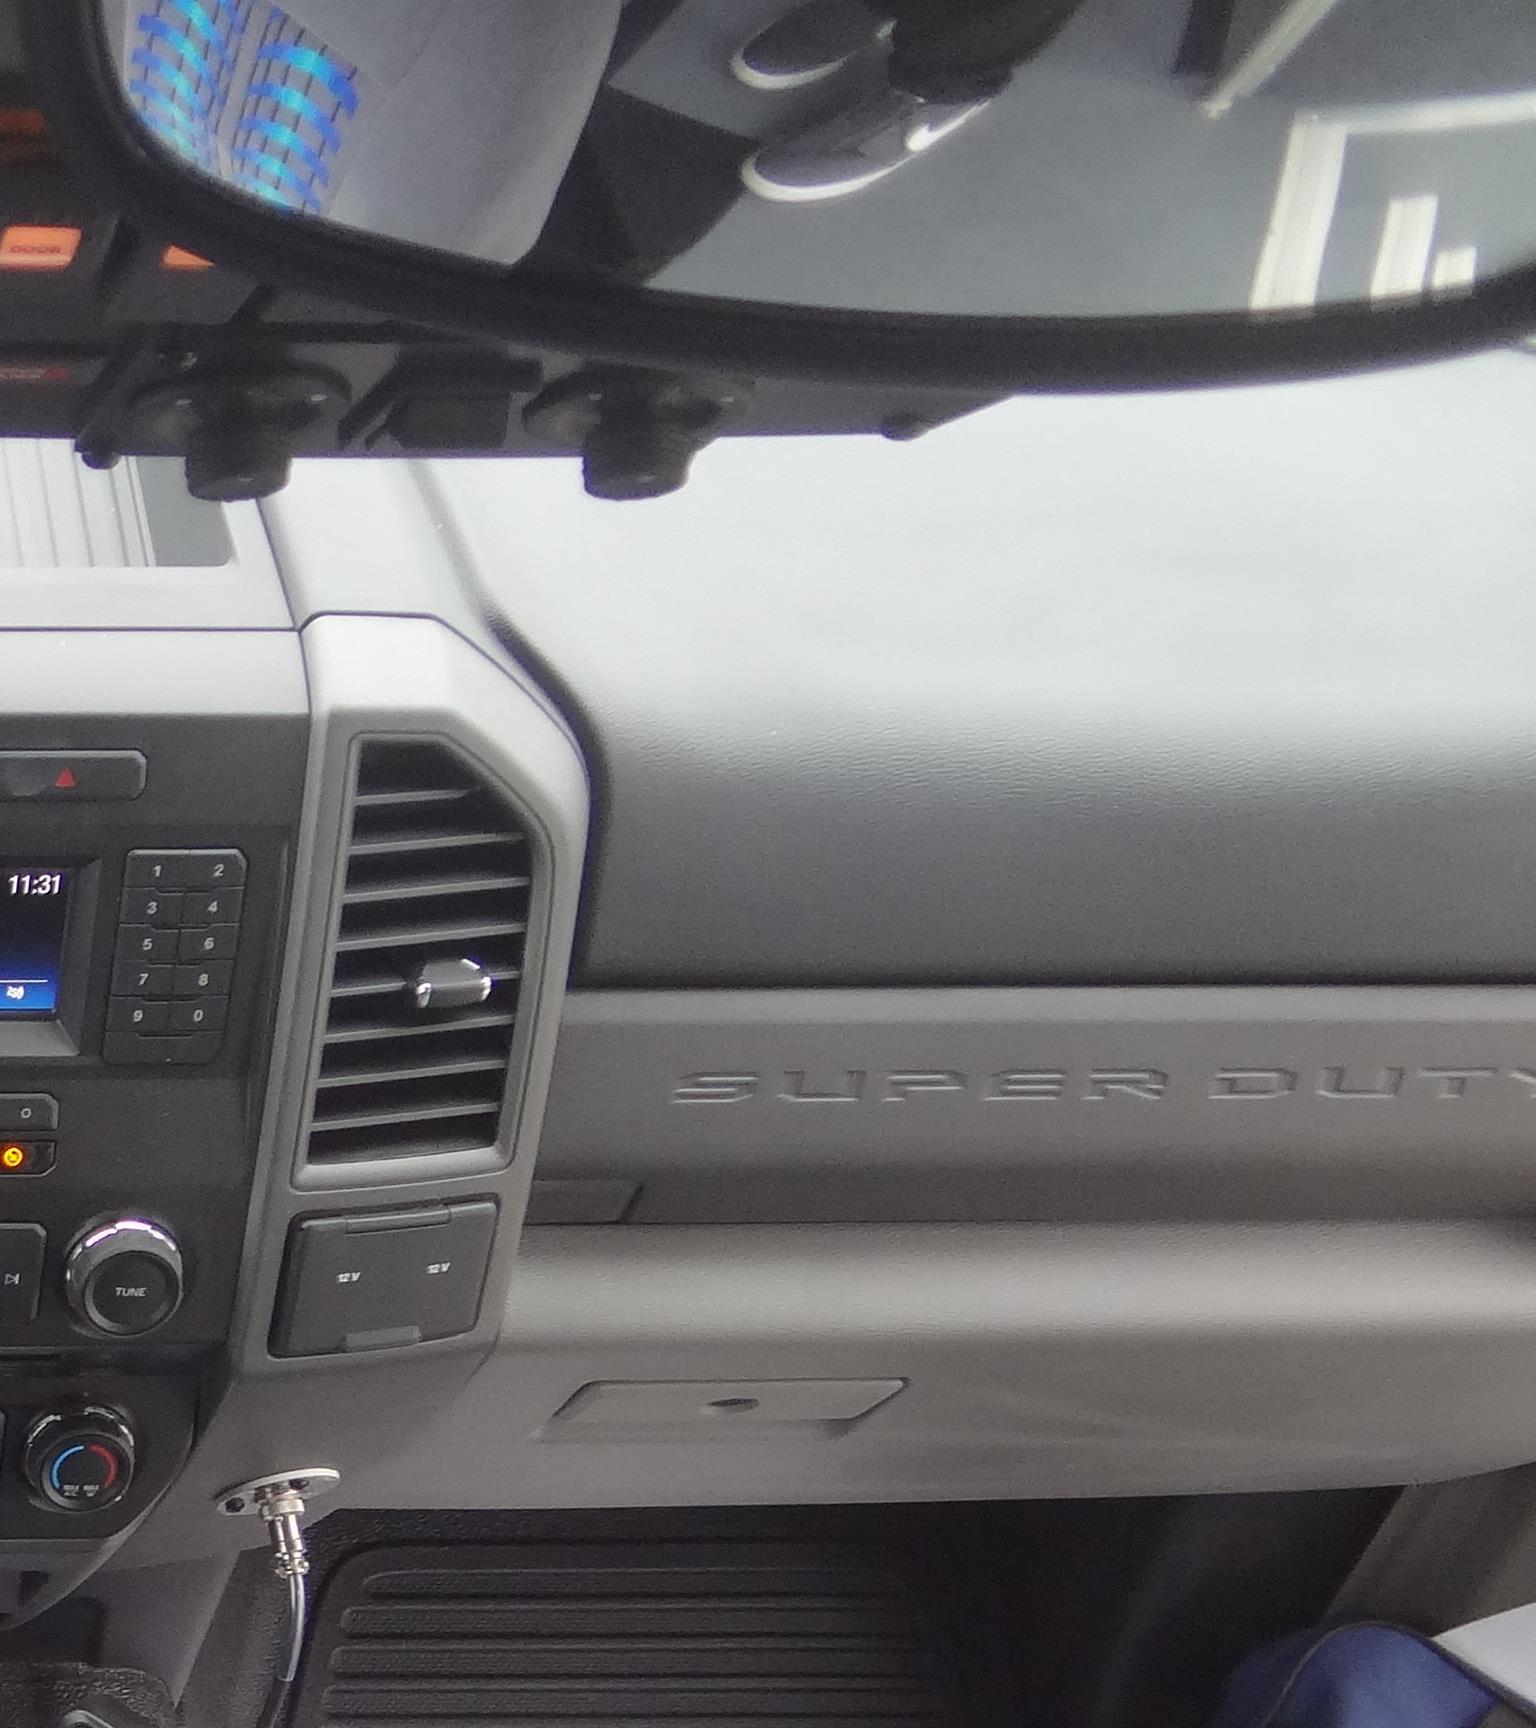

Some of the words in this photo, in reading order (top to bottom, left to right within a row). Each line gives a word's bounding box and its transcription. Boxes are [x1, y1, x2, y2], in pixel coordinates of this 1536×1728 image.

[154, 865, 162, 877] 1
[213, 864, 224, 877] 2
[8, 874, 62, 895] 11:31
[146, 901, 158, 914] 3
[207, 901, 218, 912] 4
[142, 938, 153, 950] 5
[204, 937, 214, 949] 6
[139, 973, 149, 986] 7
[198, 973, 209, 986] 8
[133, 1010, 143, 1022] 9
[193, 1009, 204, 1022] 0
[672, 1067, 1171, 1104] SUPER
[427, 1263, 440, 1274] 12
[337, 1272, 351, 1283] 12
[115, 1287, 147, 1298] TUNE
